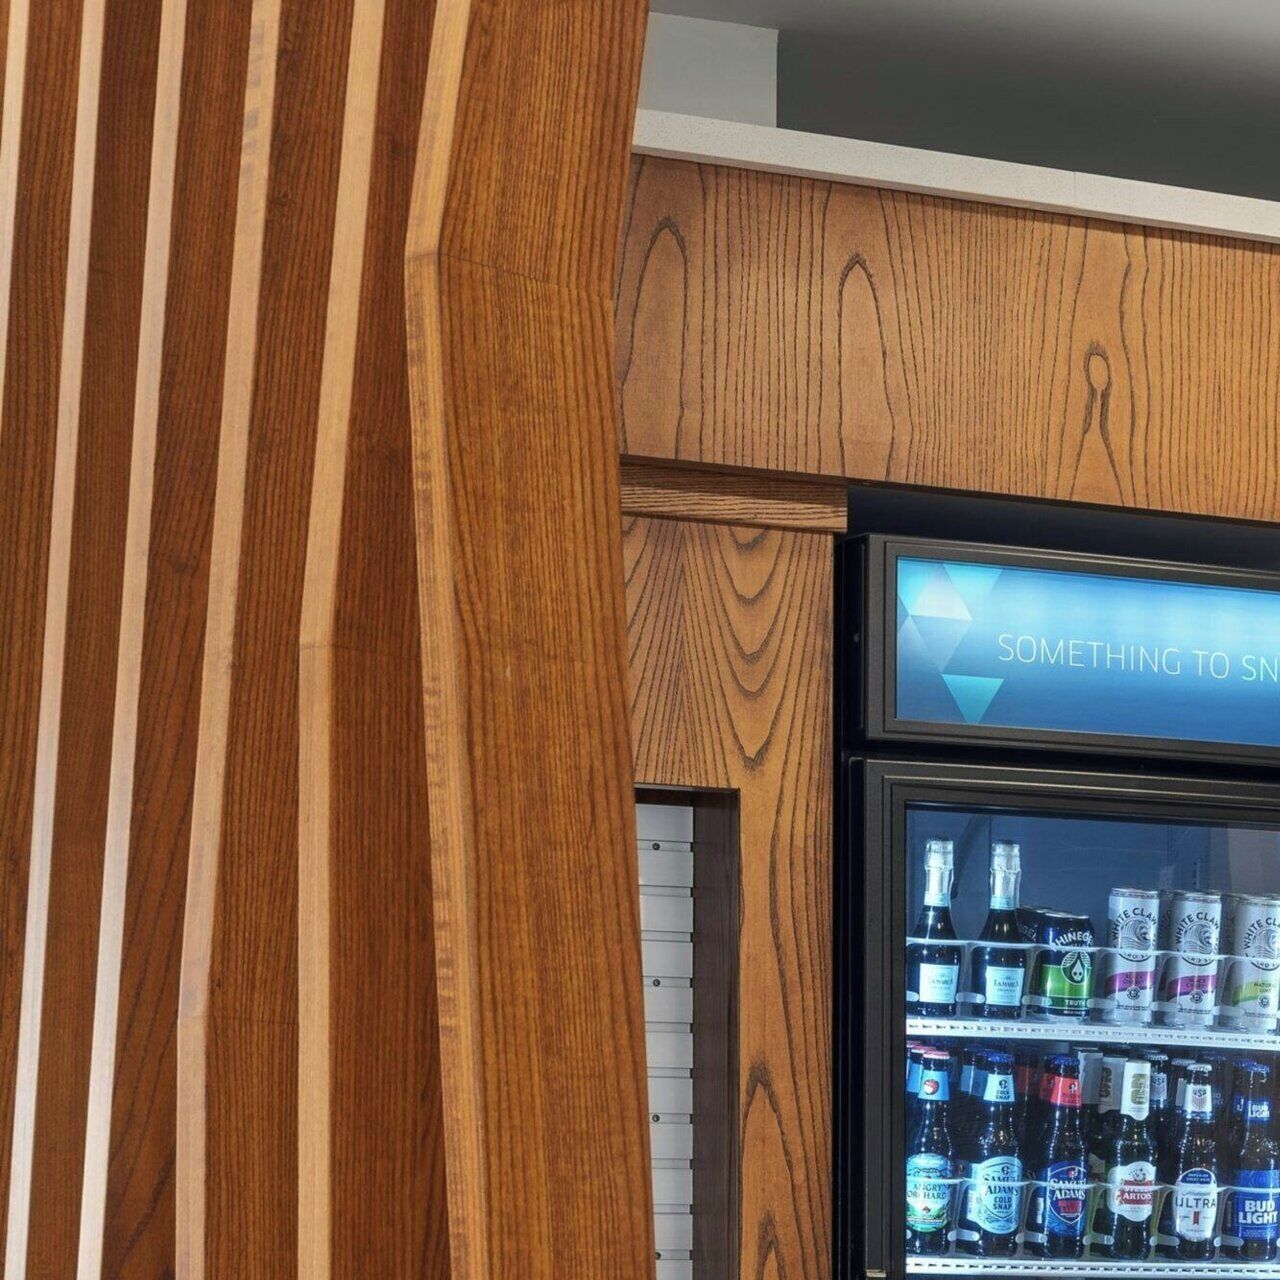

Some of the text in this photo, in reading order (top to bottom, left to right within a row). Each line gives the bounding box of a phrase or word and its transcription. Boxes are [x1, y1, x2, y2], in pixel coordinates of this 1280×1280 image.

[997, 633, 1182, 676] SOMETHING
[1192, 650, 1230, 679] TO
[1111, 908, 1130, 942] WHITE
[1175, 914, 1194, 945] WHITE
[1244, 919, 1263, 950] WHITE
[985, 1186, 1019, 1196] ADAMS
[1052, 1189, 1086, 1200] ADAMS
[1175, 1196, 1216, 1208] ULTRA
[1244, 1200, 1275, 1212] BUD
[1238, 1211, 1278, 1224] LIGHT
